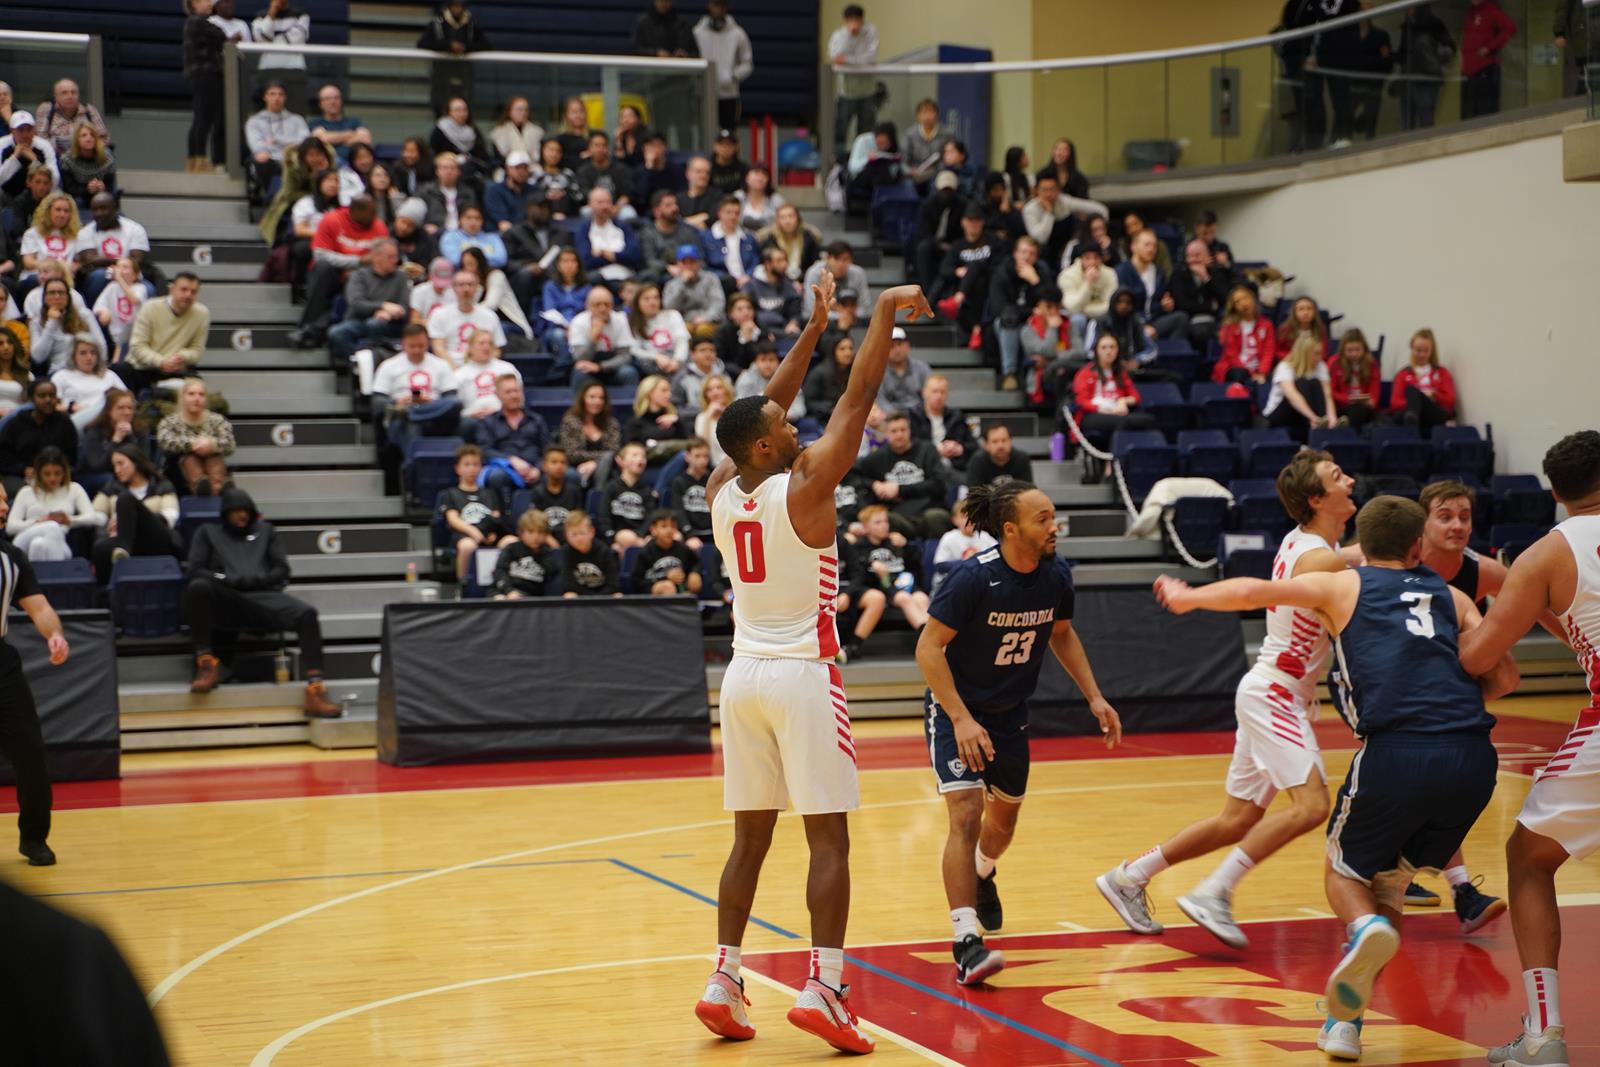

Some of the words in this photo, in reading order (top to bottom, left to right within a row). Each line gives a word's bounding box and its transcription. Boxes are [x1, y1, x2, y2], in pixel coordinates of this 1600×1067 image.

[192, 245, 212, 266] G
[231, 328, 252, 351] G
[271, 423, 293, 447] G
[317, 530, 341, 554] G
[733, 521, 766, 583] 0
[987, 607, 1055, 627] CONCORDIA
[1399, 591, 1435, 639] 3
[994, 630, 1037, 666] 23
